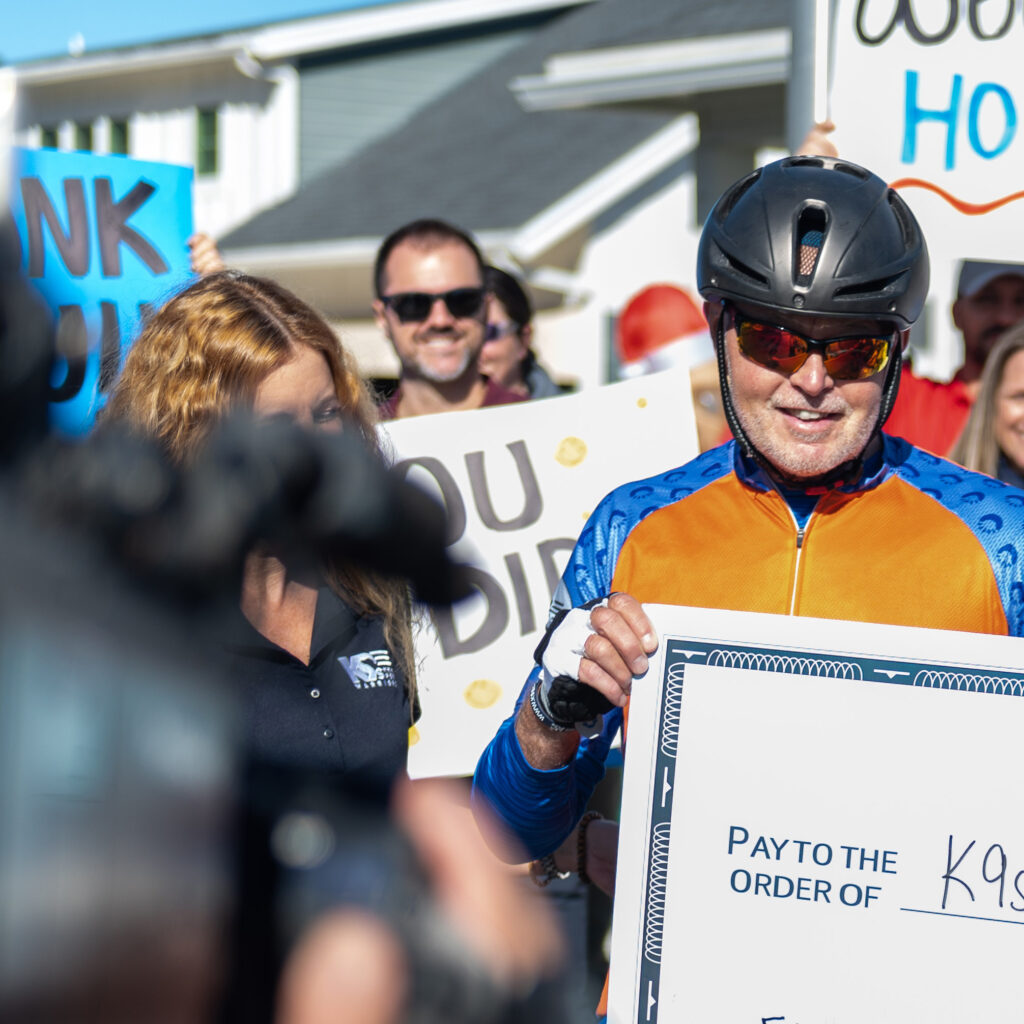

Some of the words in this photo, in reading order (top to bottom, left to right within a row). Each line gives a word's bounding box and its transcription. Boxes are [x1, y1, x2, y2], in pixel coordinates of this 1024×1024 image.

[840, 845, 899, 875] THE
[730, 868, 832, 904] ORDER
[839, 883, 883, 909] OF
